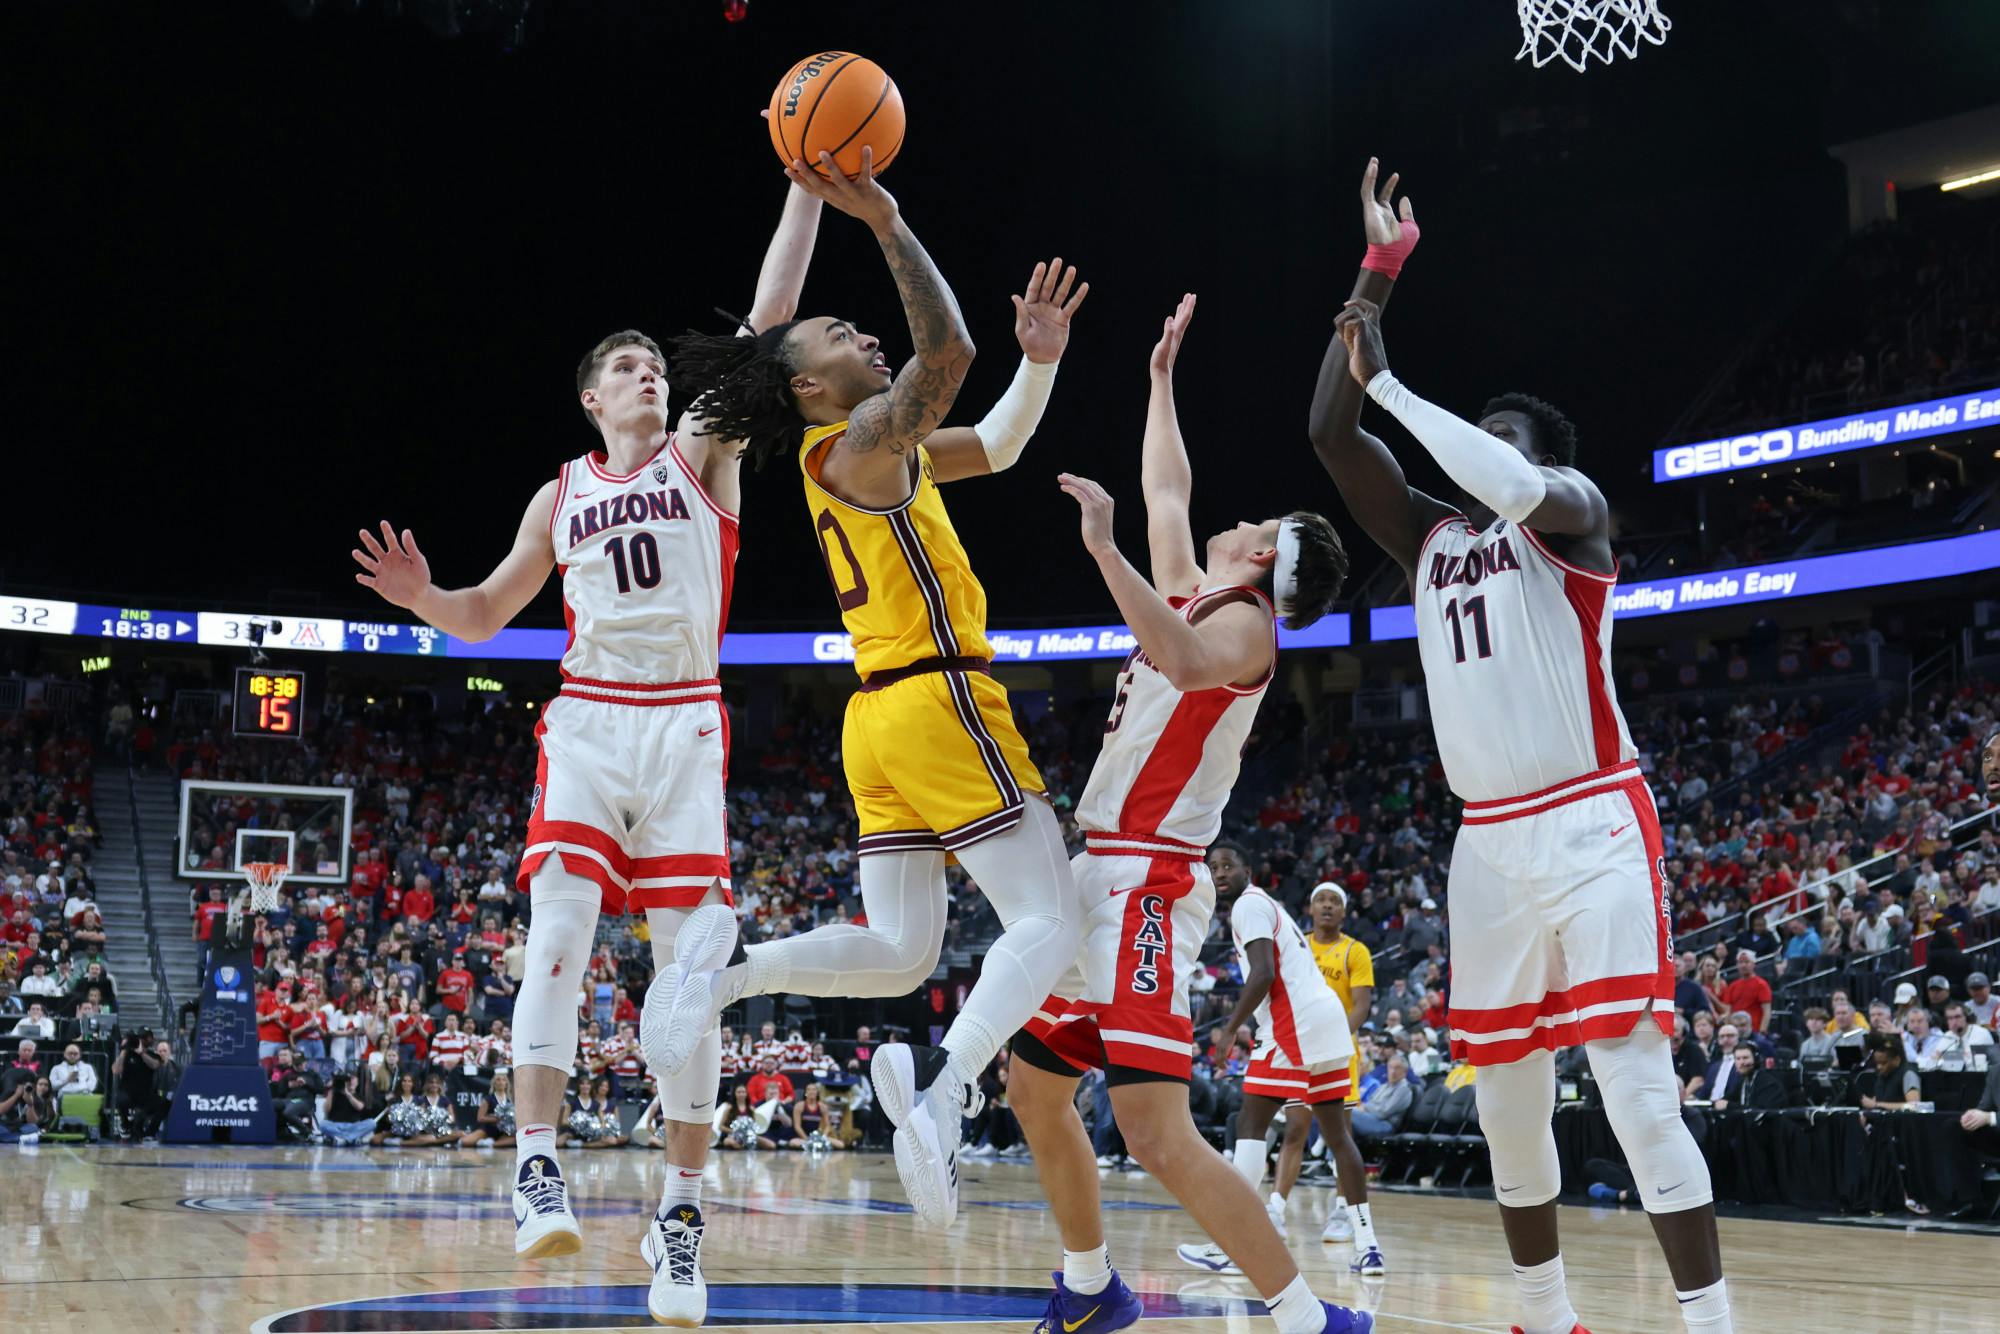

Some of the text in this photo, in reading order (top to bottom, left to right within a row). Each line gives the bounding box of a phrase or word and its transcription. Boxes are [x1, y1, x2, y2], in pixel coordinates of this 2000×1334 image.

[1665, 398, 2000, 477] GEICO Bundling Made Eas
[569, 488, 692, 550] ARIZONA
[603, 531, 662, 593] 10
[1613, 572, 1797, 611] ndling Made Easy
[11, 605, 49, 626] 32
[120, 608, 151, 621] 2ND
[101, 619, 171, 640] 18:38
[349, 623, 398, 636] FOULS
[410, 626, 438, 639] TOL
[1445, 595, 1493, 664] 11
[363, 634, 379, 652] 0
[417, 637, 433, 655] 3
[988, 631, 1138, 659] dling Made Eas
[250, 675, 298, 699] 18:38
[260, 697, 292, 732] 15
[1132, 894, 1167, 995] CATS
[187, 1094, 259, 1112] TaxAct
